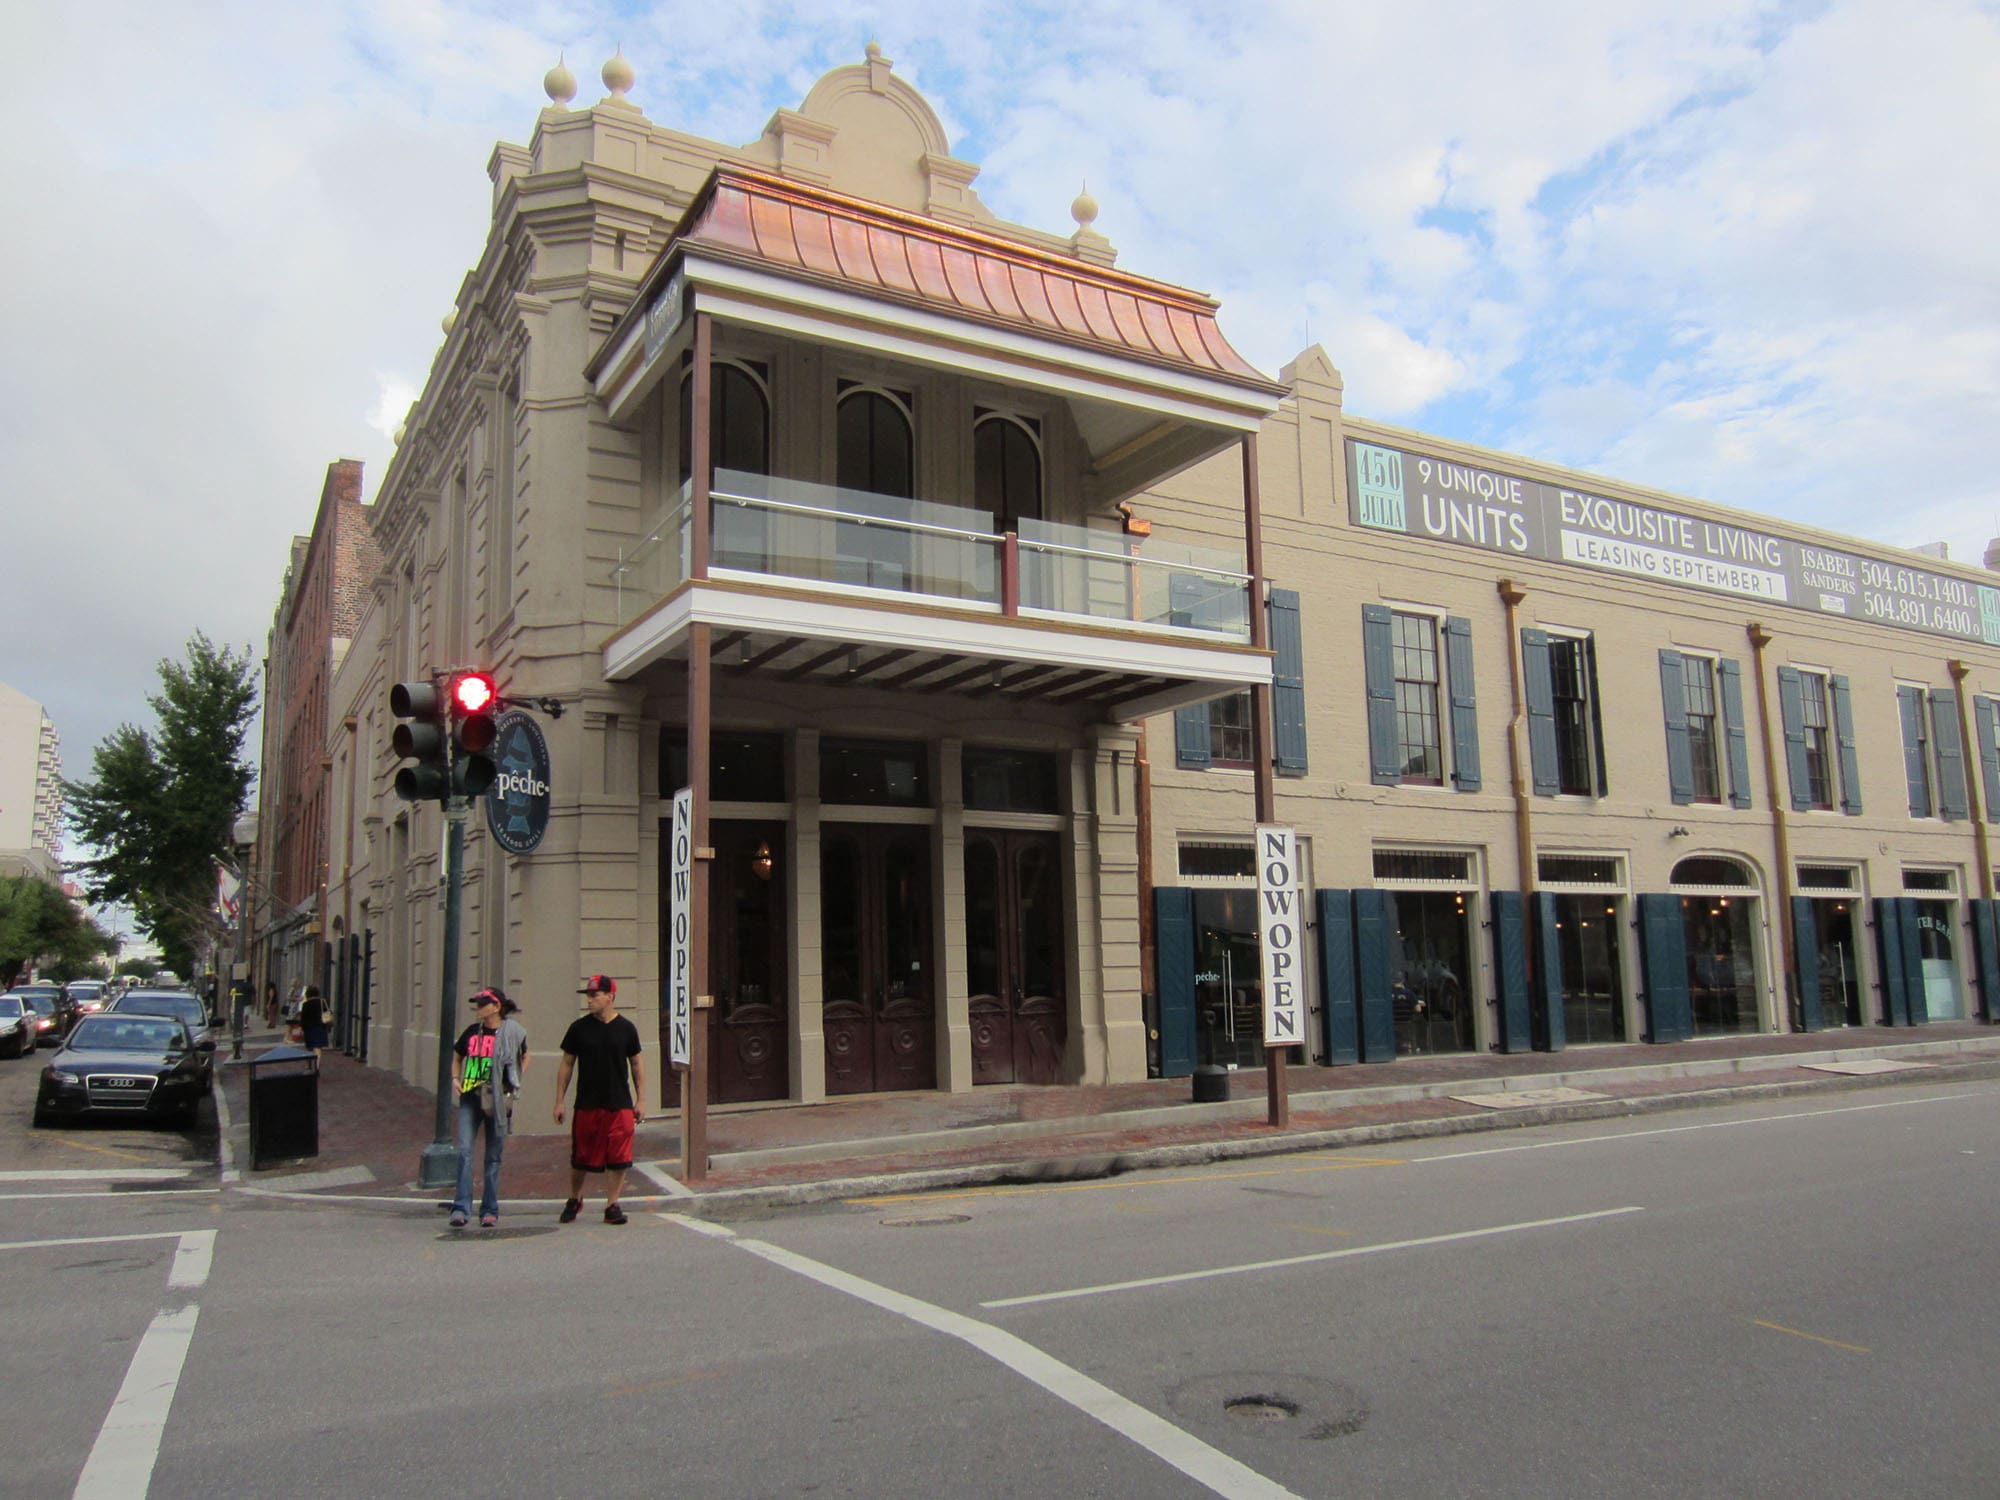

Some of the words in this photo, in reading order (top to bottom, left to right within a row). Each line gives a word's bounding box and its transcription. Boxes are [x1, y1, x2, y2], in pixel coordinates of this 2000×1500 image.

[1360, 449, 1400, 491] 450
[1418, 460, 1431, 484] 9
[1437, 463, 1523, 505] UNIQUE
[1363, 494, 1402, 528] JULIA
[1422, 494, 1528, 551] UNITS
[1560, 491, 1695, 550] EXQUISITE
[1704, 524, 1782, 567] LIVING
[1575, 538, 1656, 571] LEASING
[1663, 556, 1761, 592] SEPTEMBER
[1766, 577, 1773, 594] 1
[1800, 548, 1855, 577] ISABEL
[1803, 571, 1857, 595] SANDERS
[674, 798, 689, 902] NOW
[1263, 833, 1294, 915] NOW
[674, 912, 688, 1056] OPEN
[1269, 923, 1296, 1037] OPEN
